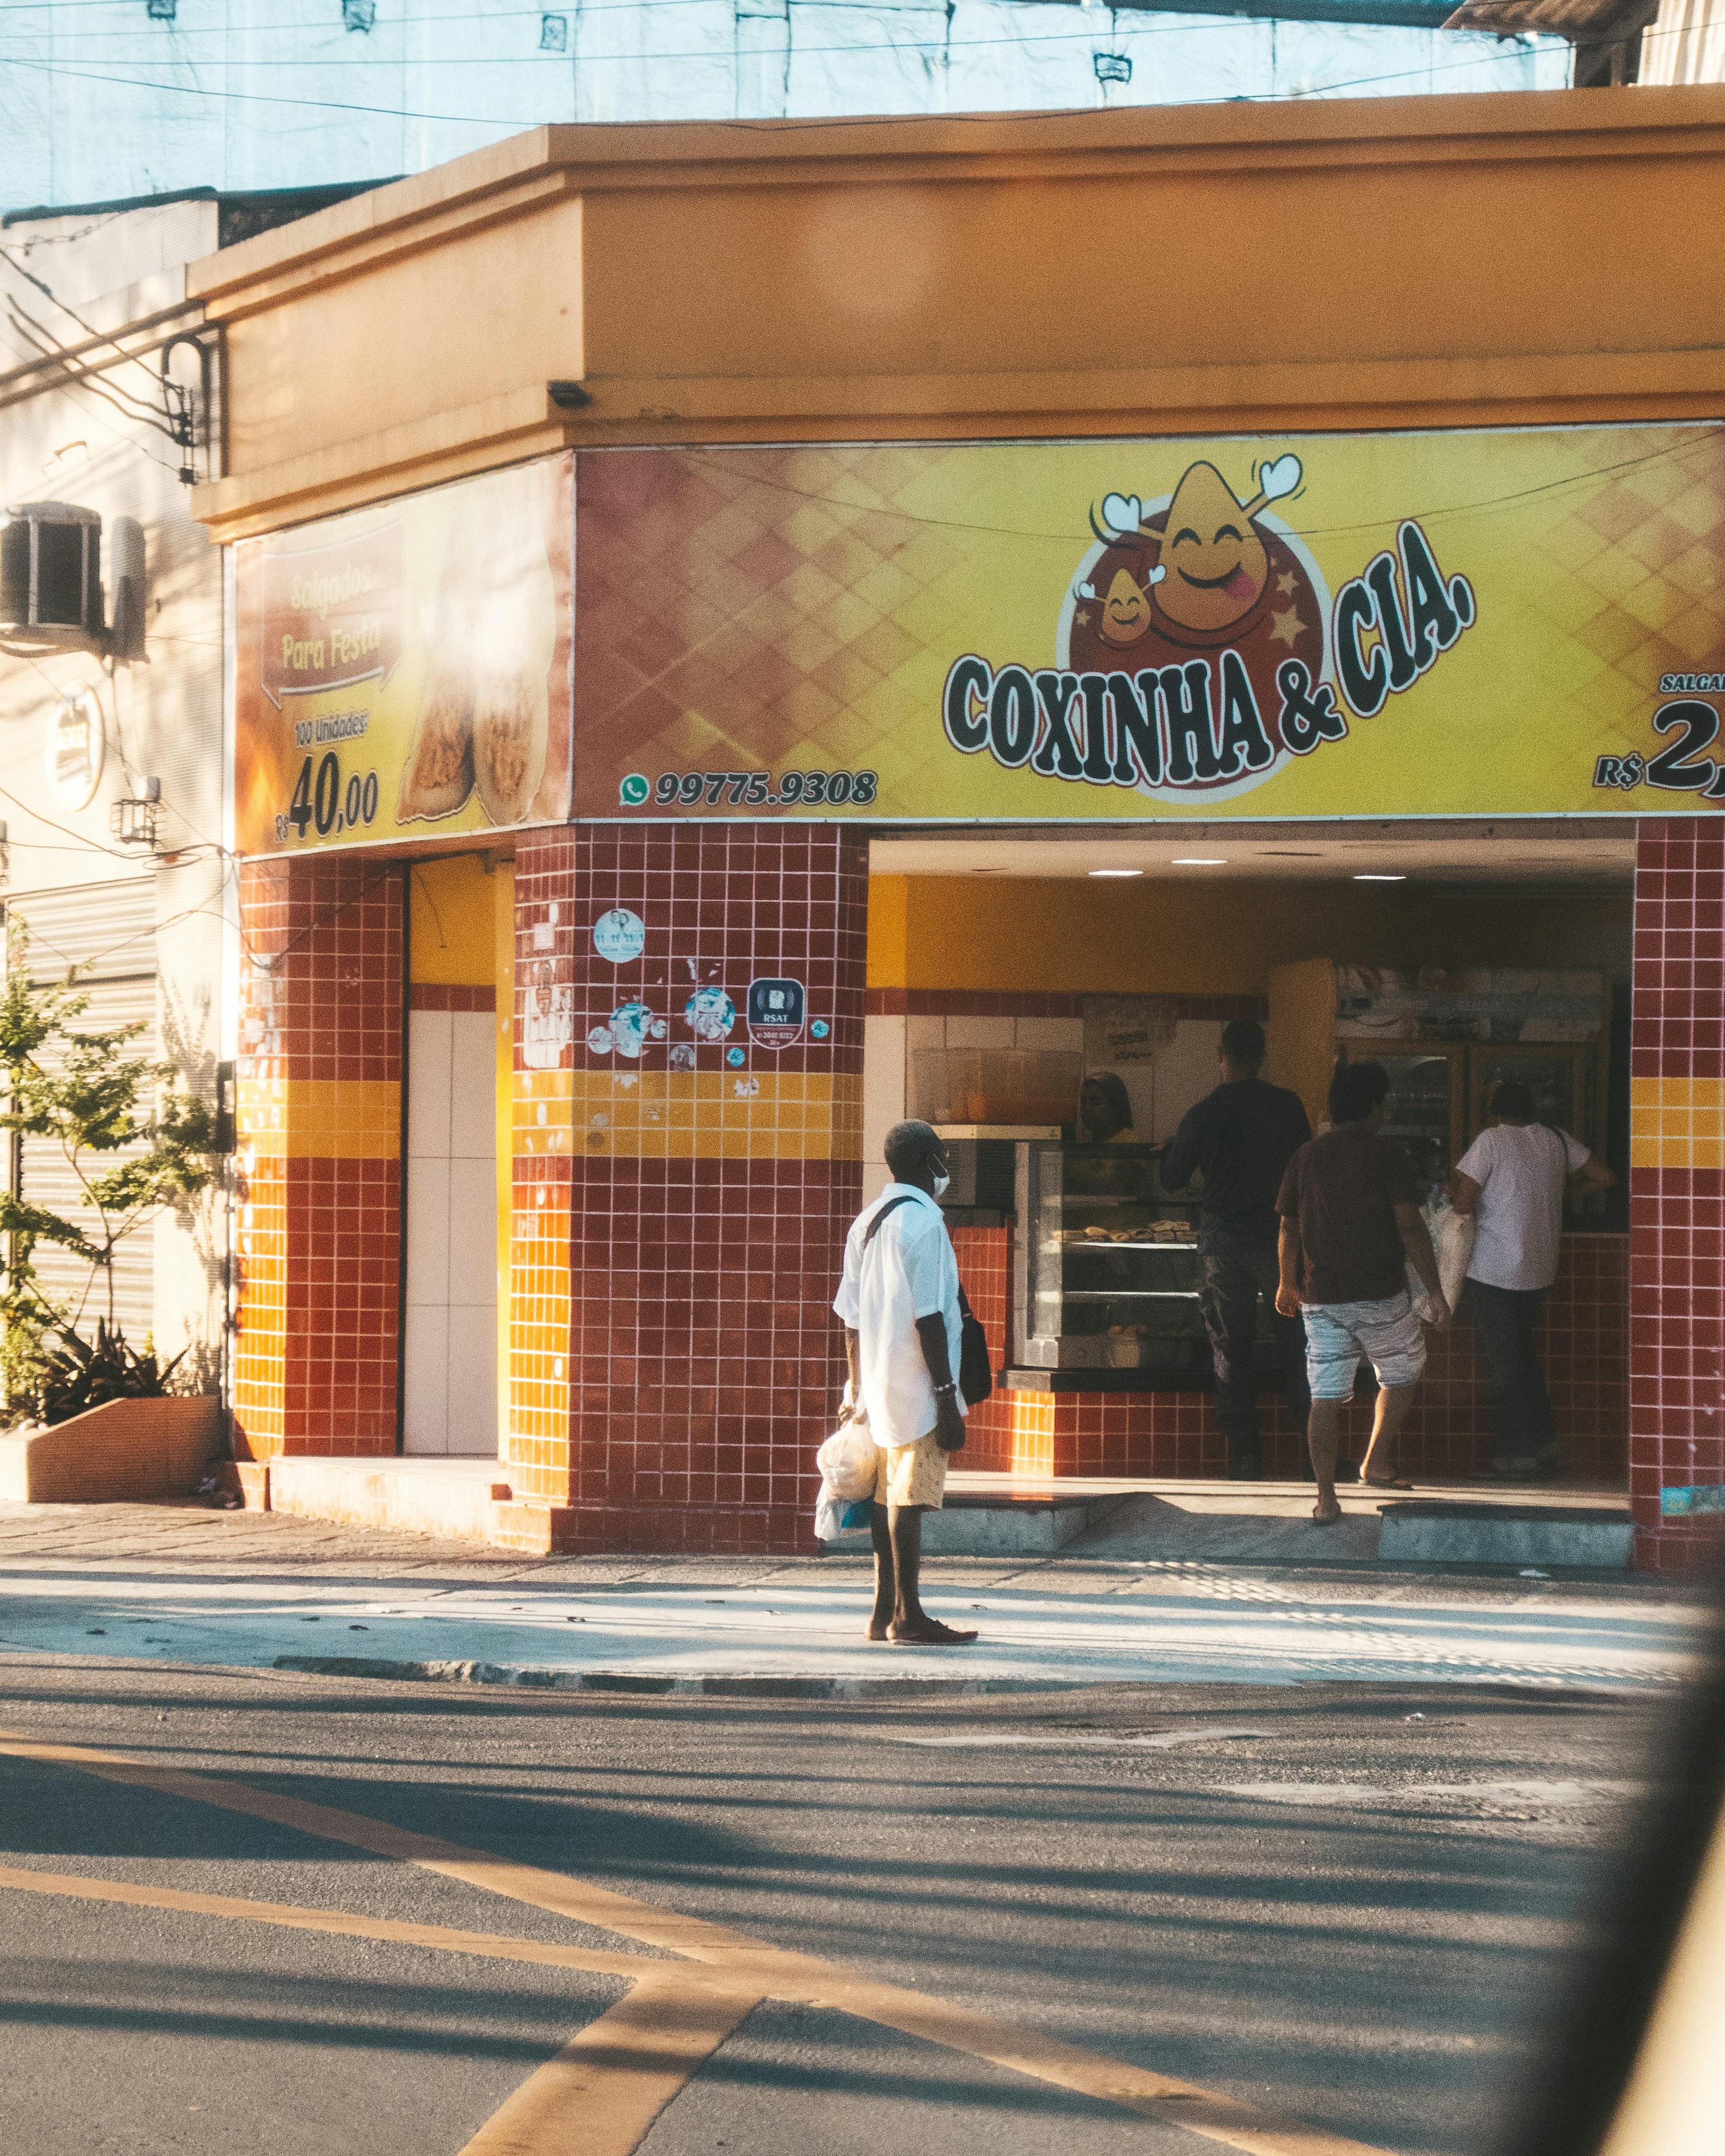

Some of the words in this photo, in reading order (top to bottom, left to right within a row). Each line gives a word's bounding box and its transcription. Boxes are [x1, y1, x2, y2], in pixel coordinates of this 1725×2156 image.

[282, 632, 325, 671] Para
[330, 622, 381, 667] Festa
[943, 649, 1275, 788] COXINHA
[1277, 657, 1349, 756] &
[656, 771, 877, 805] 99775.9308
[1593, 752, 1643, 790] R$
[289, 750, 378, 840] 40,00
[763, 1014, 789, 1022] RSAT
